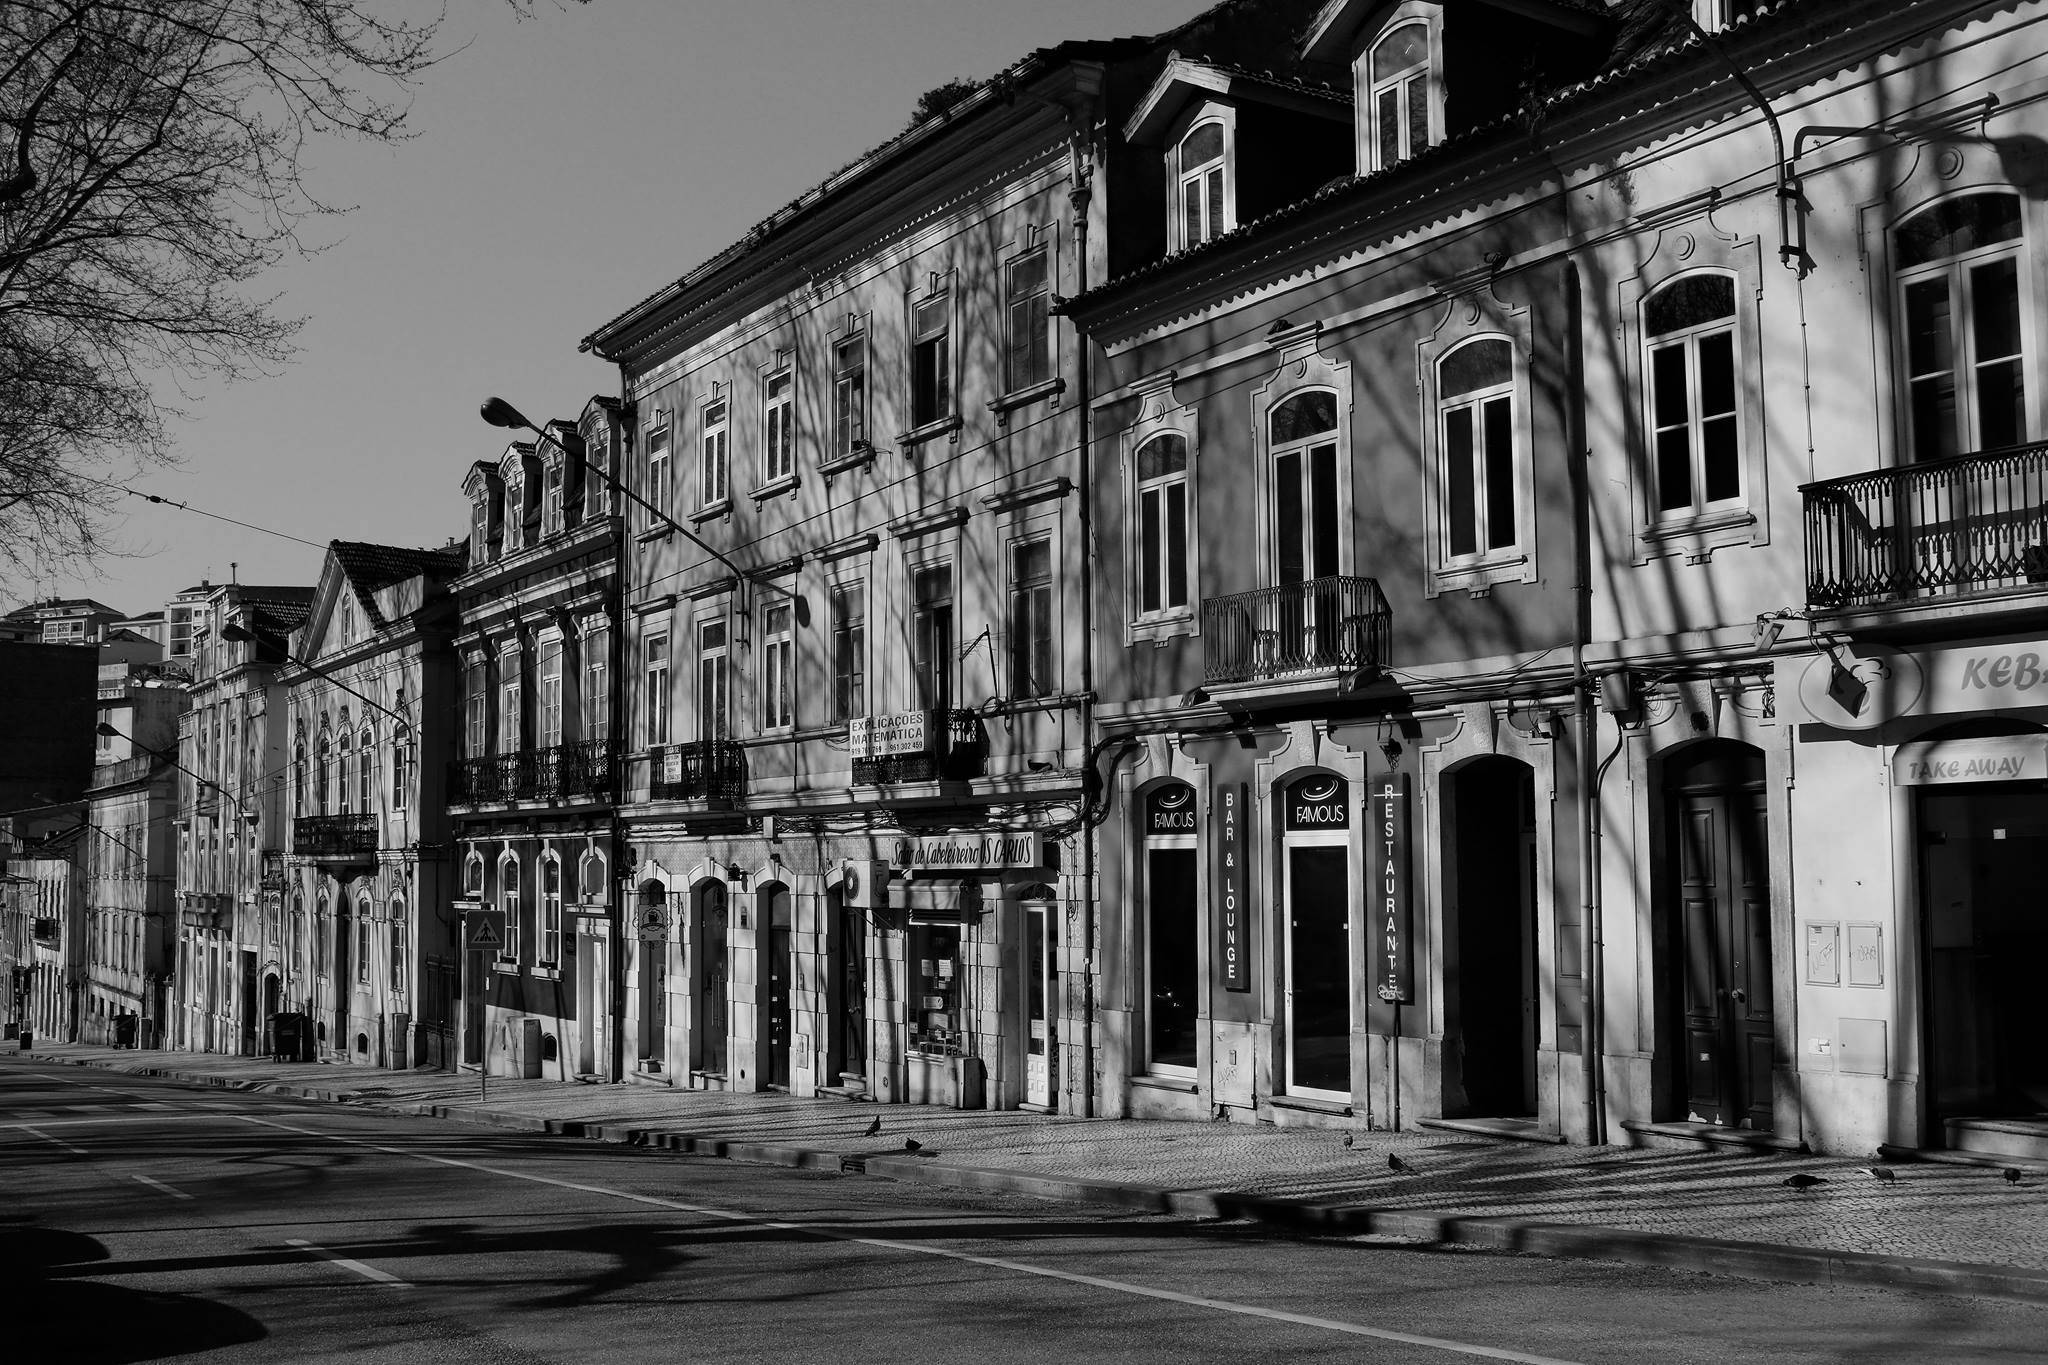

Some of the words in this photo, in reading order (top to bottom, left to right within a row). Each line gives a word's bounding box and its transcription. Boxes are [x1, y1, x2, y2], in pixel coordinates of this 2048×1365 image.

[1961, 653, 2048, 691] KEB
[1909, 760, 1960, 779] TAKE
[1964, 756, 2025, 777] AWAY
[1154, 811, 1195, 828] FAMOUS
[1225, 793, 1234, 841] BAR
[1296, 804, 1344, 823] FAMOUS
[914, 841, 925, 865] de
[926, 841, 979, 865] Cabeleireiro
[980, 837, 994, 865] OS
[1225, 852, 1234, 867] &
[1384, 784, 1397, 990] RESTAURANTE
[1226, 878, 1236, 979] LOUNGE
